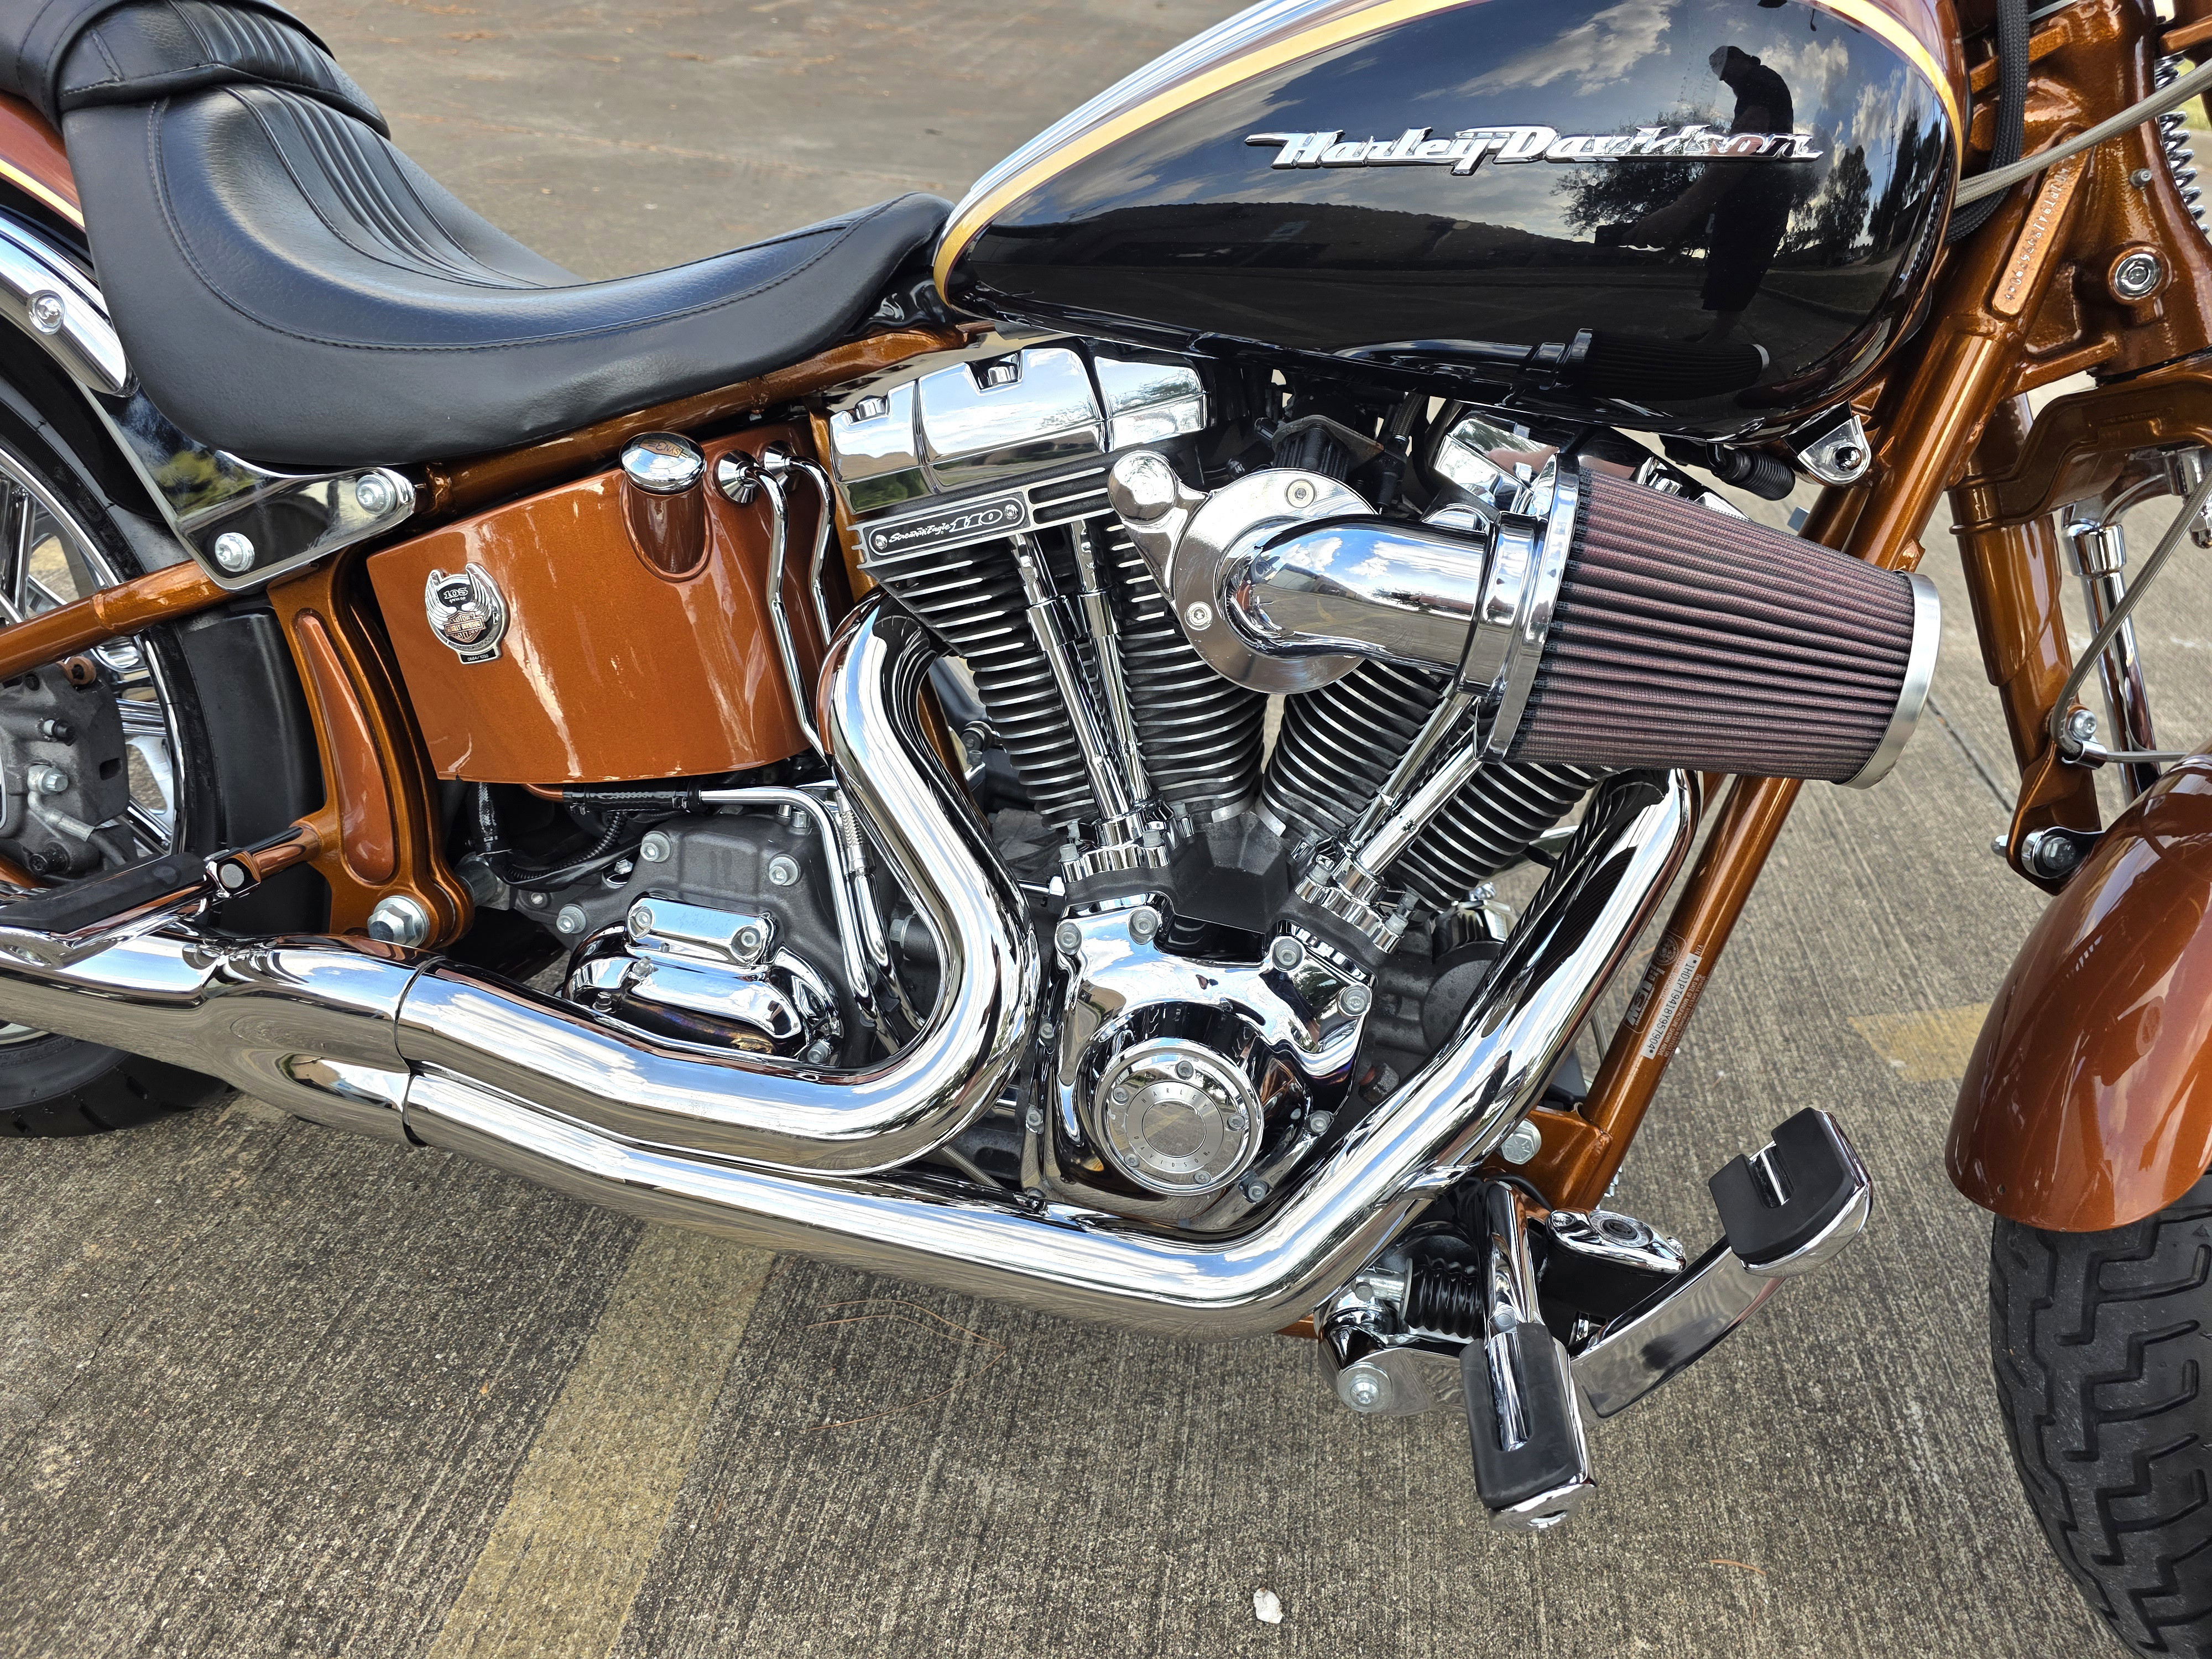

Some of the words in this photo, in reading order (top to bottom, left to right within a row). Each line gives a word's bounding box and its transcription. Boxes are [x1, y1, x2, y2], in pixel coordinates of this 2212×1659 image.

[949, 509, 1003, 533] 110
[443, 587, 468, 600] 105
[1140, 1087, 1208, 1108] HARLEY
[1134, 1135, 1208, 1167] DAVIDSON
